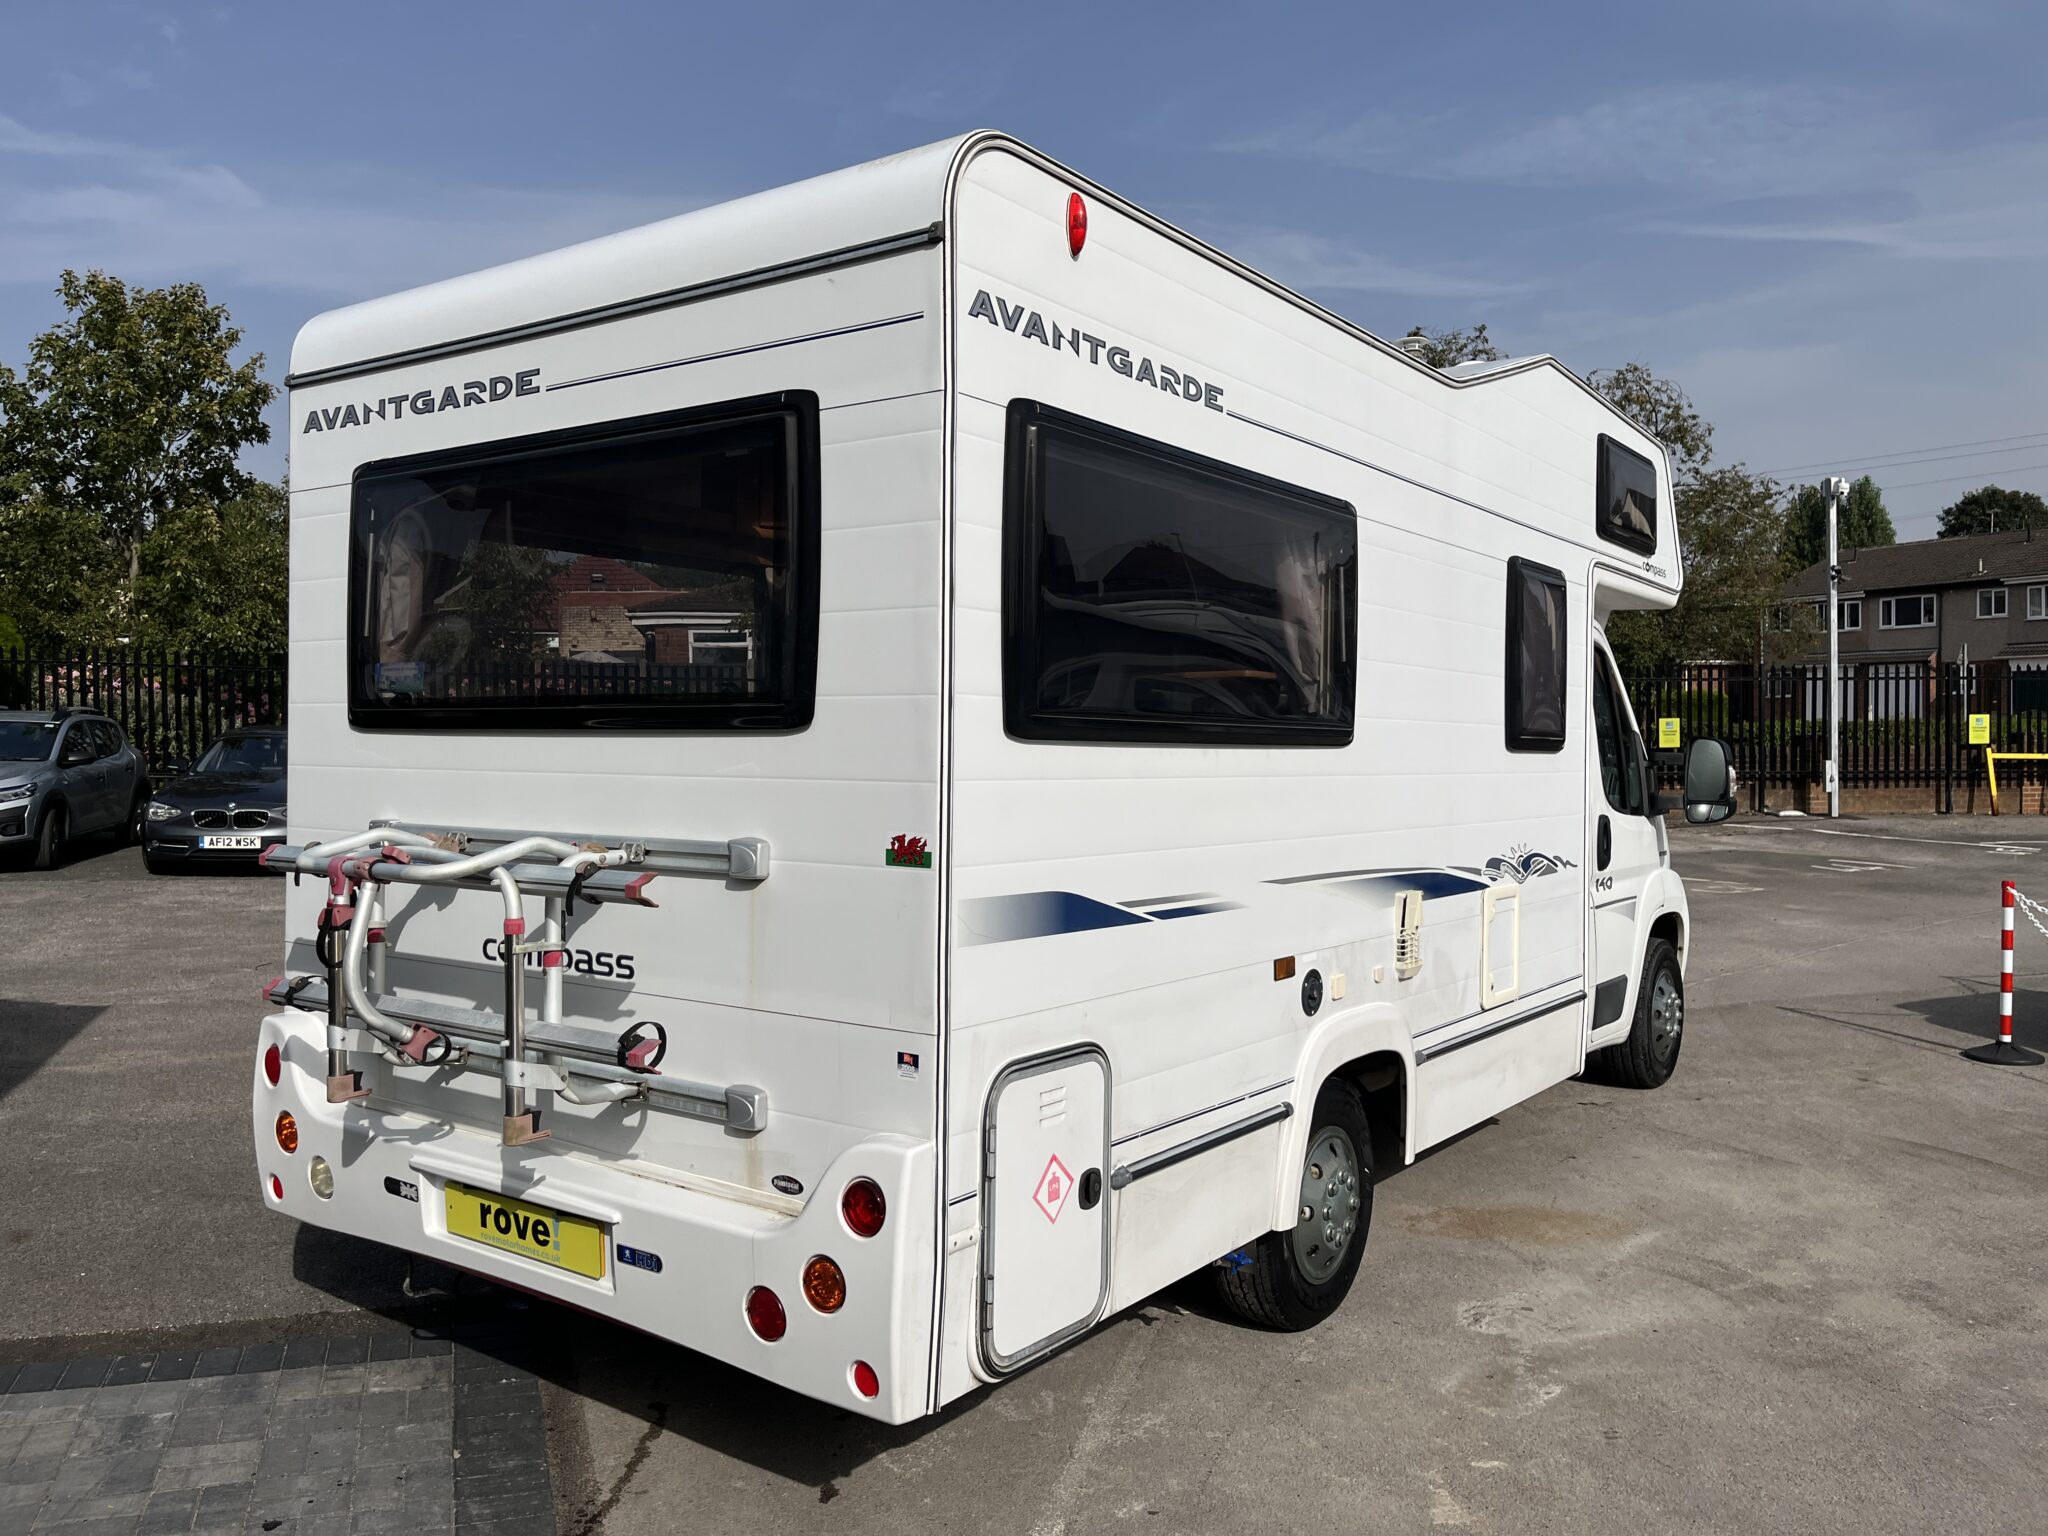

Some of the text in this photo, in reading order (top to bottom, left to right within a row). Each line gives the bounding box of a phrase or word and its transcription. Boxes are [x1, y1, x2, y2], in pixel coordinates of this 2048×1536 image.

[969, 289, 1224, 413] AVANTGARDE
[303, 368, 540, 433] AVANTGARDE
[208, 837, 257, 847] AF12 WSK
[1595, 876, 1613, 892] 140
[480, 1231, 561, 1264] rovemotorhomes.co.uk
